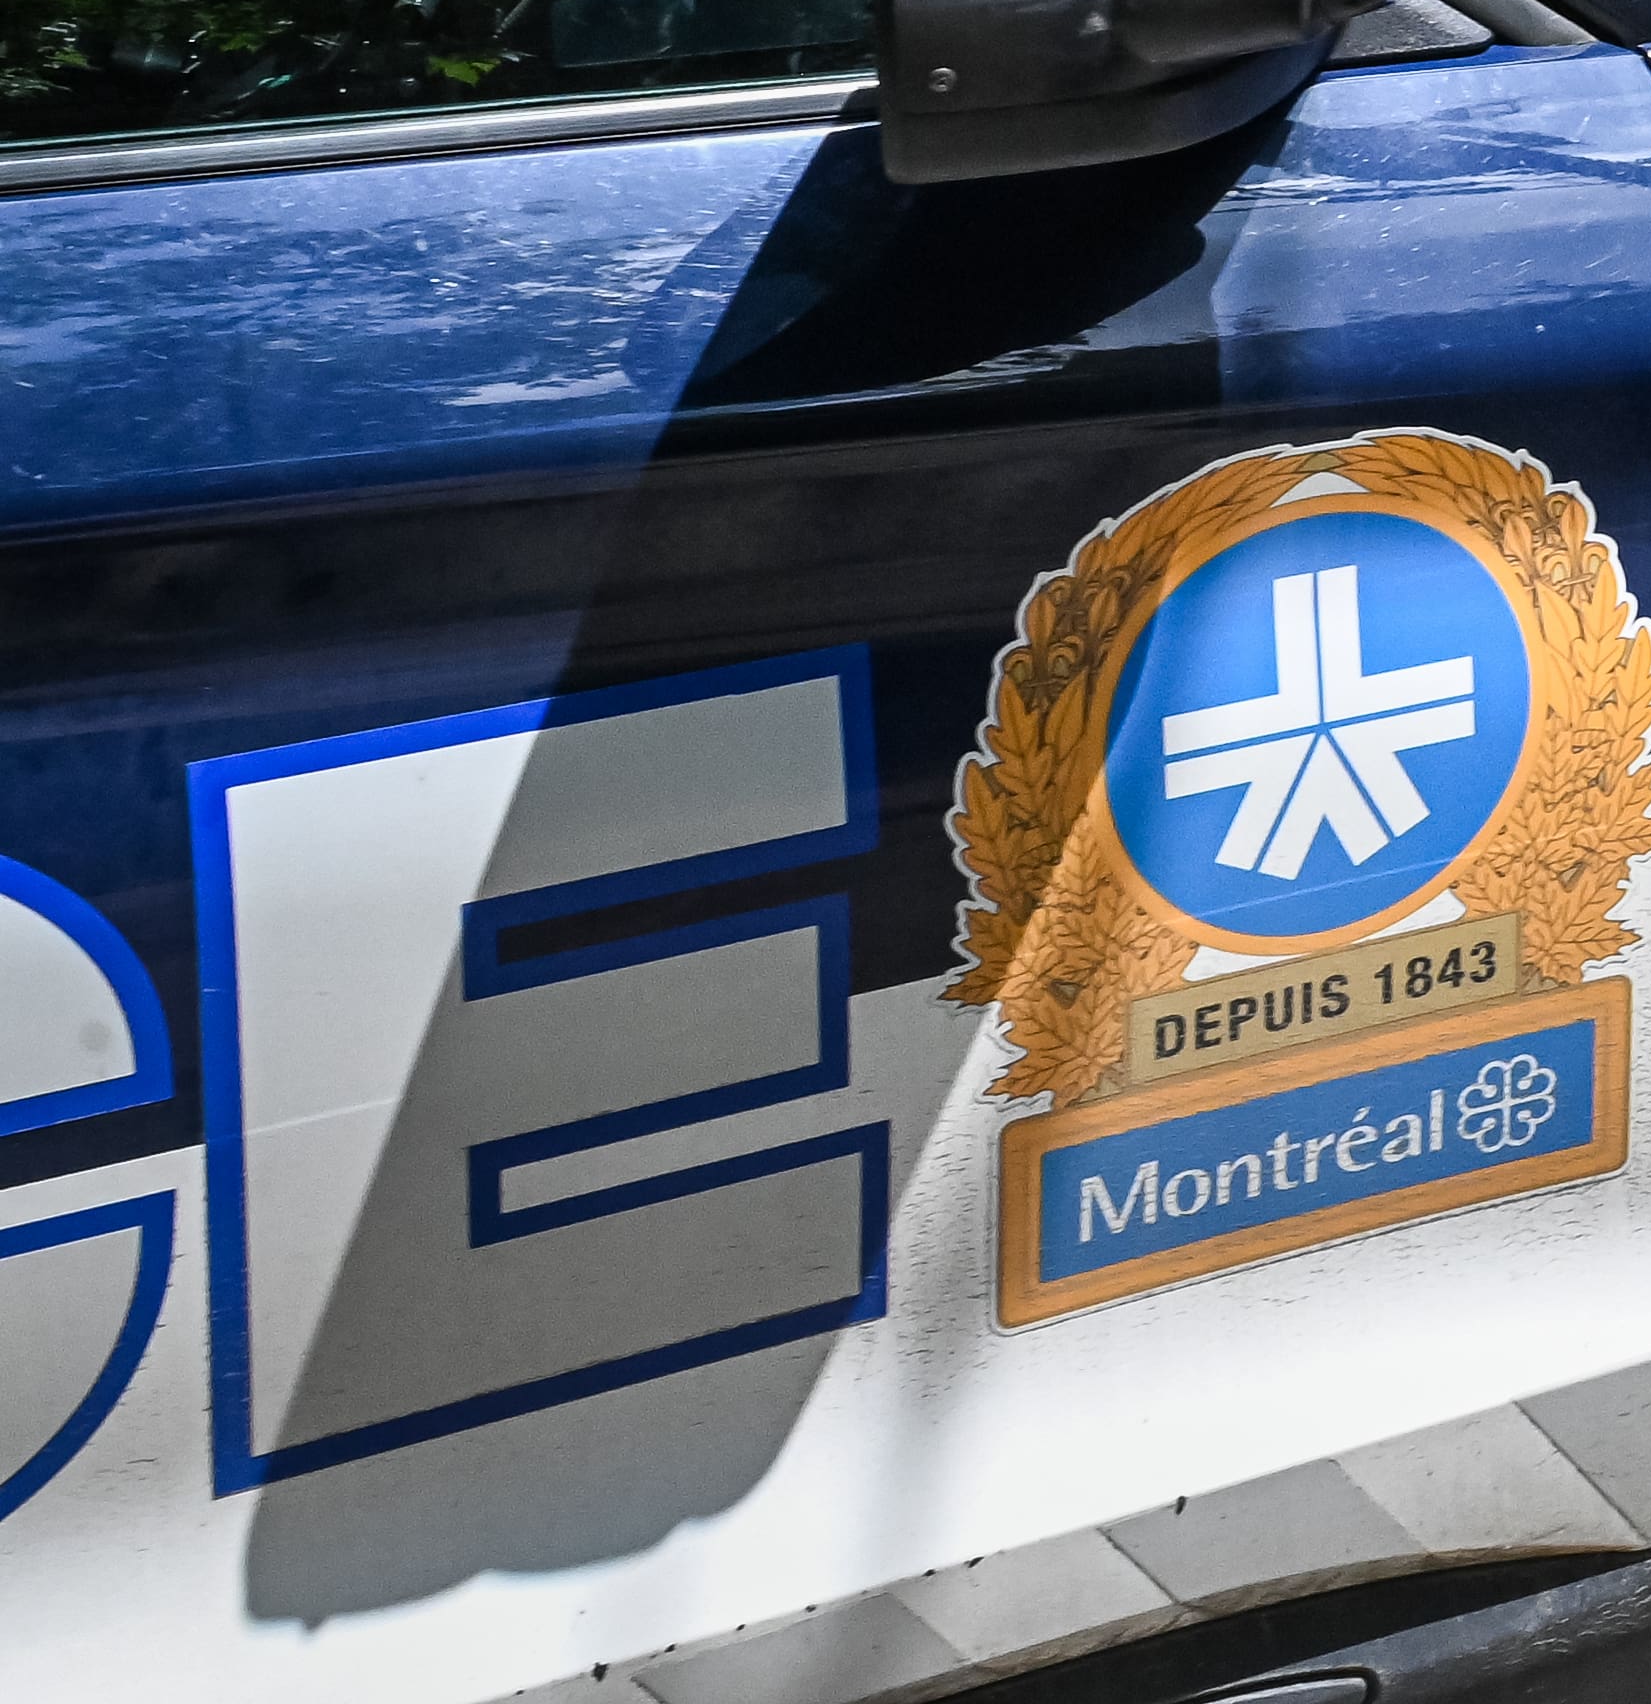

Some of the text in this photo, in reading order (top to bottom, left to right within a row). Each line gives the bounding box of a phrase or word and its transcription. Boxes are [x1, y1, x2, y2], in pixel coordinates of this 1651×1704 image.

[1153, 939, 1499, 1061] DEPUIS 1843
[0, 641, 891, 1522] E
[1077, 1087, 1446, 1245] Montréal
